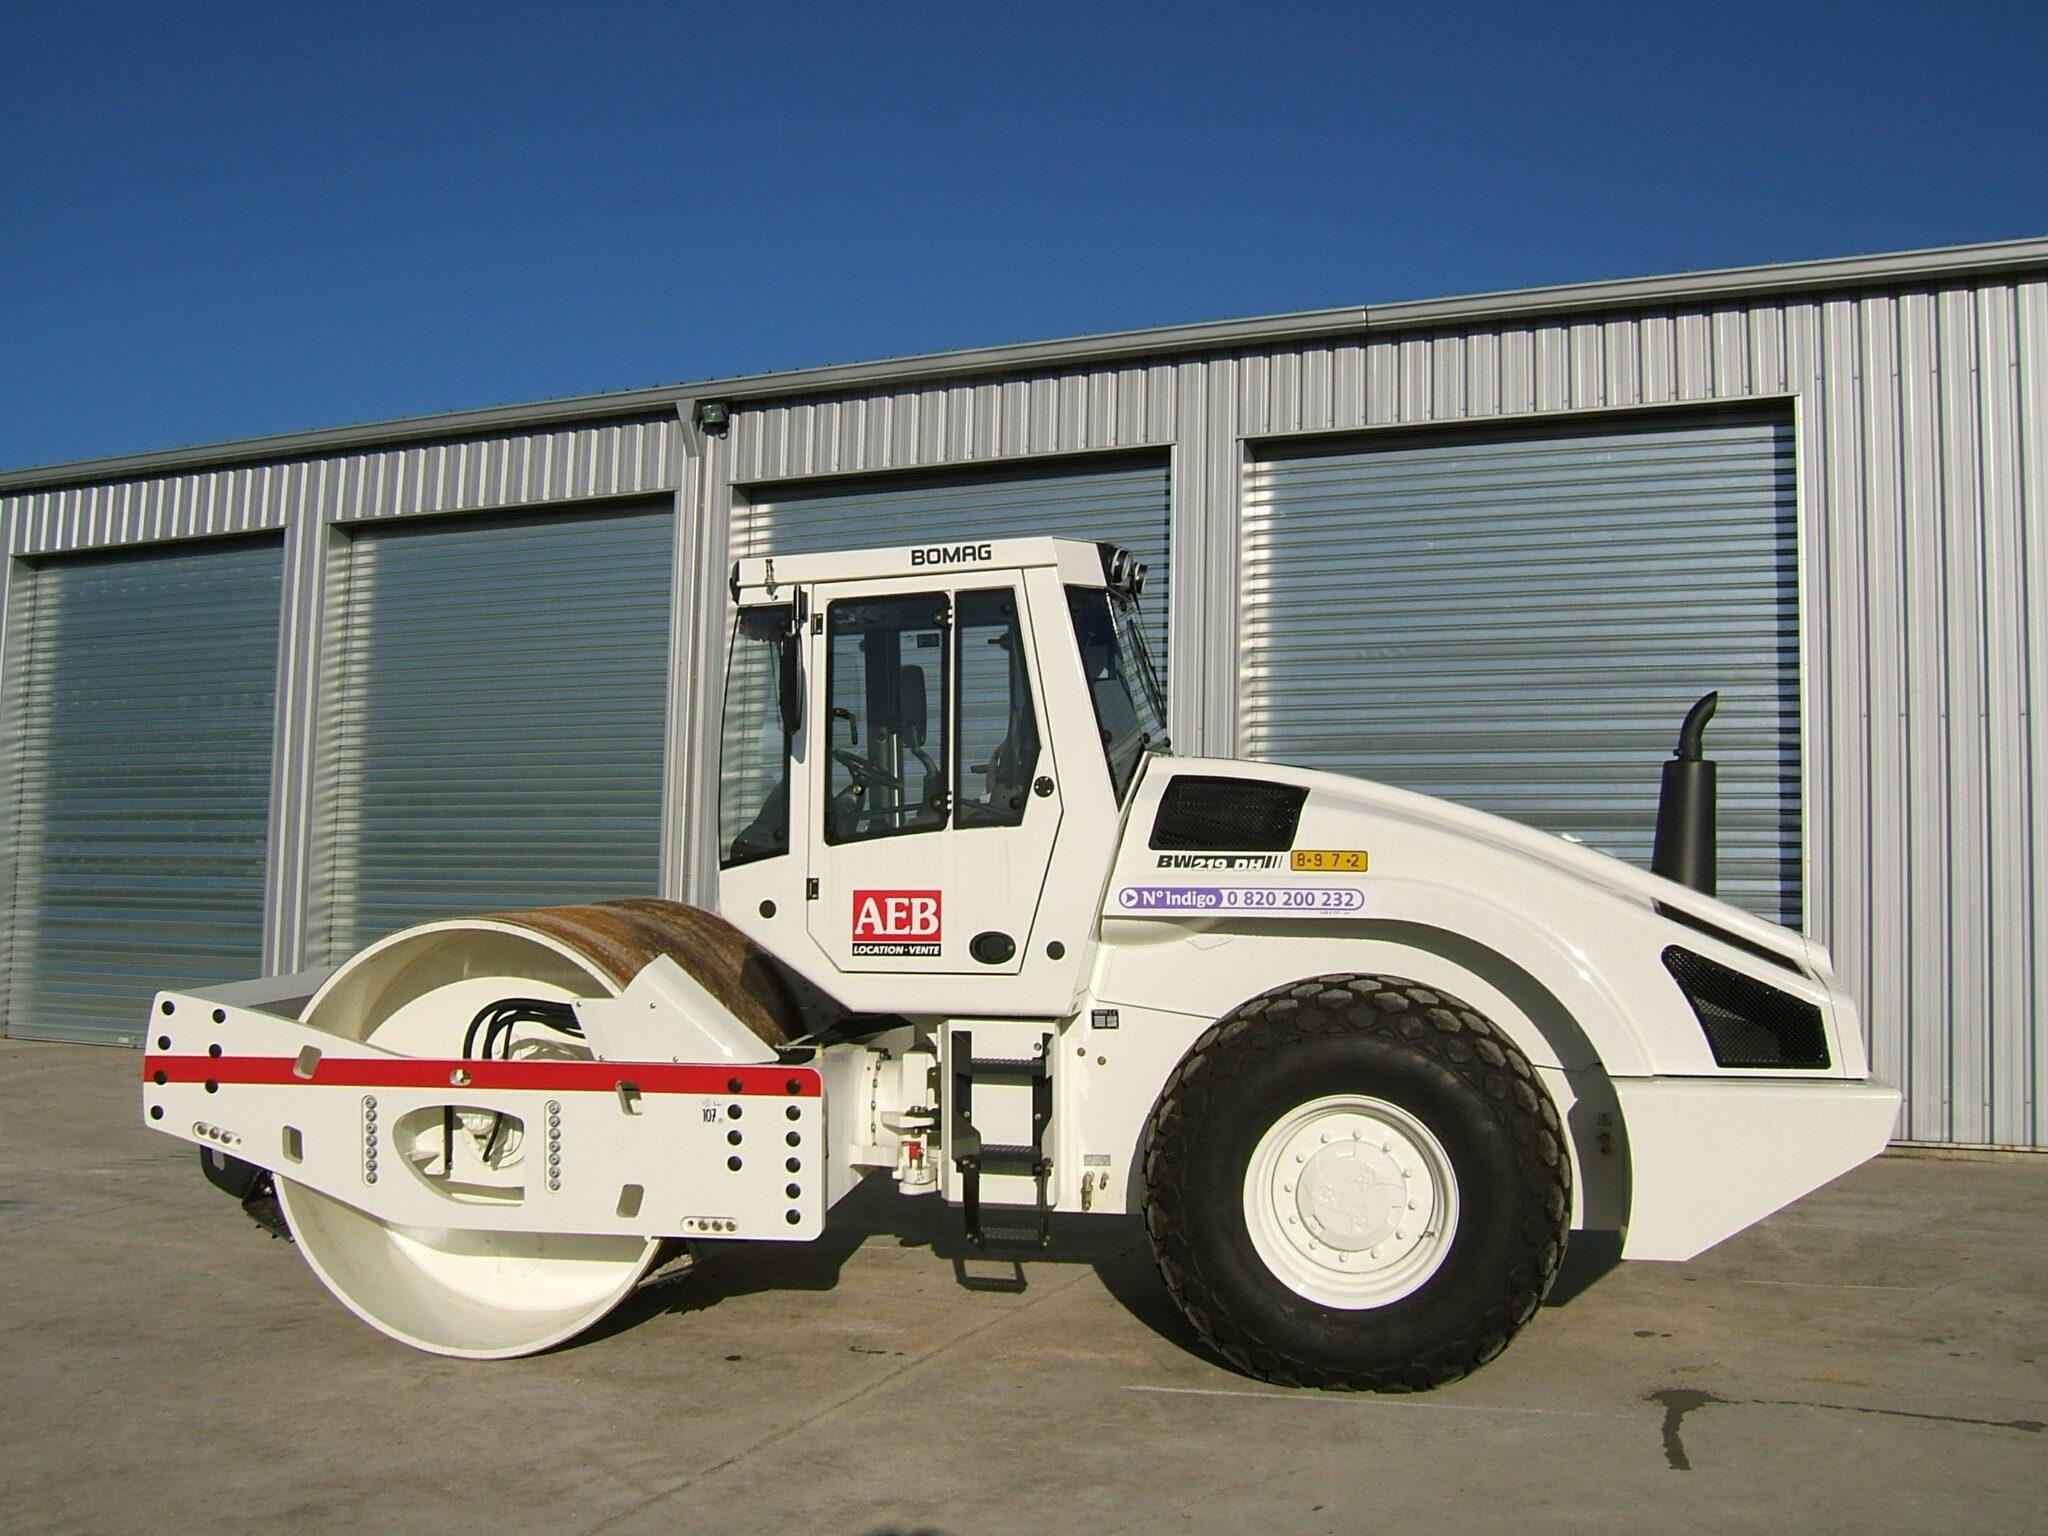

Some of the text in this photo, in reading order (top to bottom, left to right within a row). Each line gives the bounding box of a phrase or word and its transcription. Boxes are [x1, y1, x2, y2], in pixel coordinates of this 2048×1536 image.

[911, 544, 992, 566] BOMAG
[1227, 891, 1238, 906] 0
[1243, 891, 1276, 906] 820
[1282, 891, 1315, 907] 200
[1321, 892, 1354, 907] 232
[854, 897, 940, 935] AEB
[702, 1108, 717, 1123] 107
